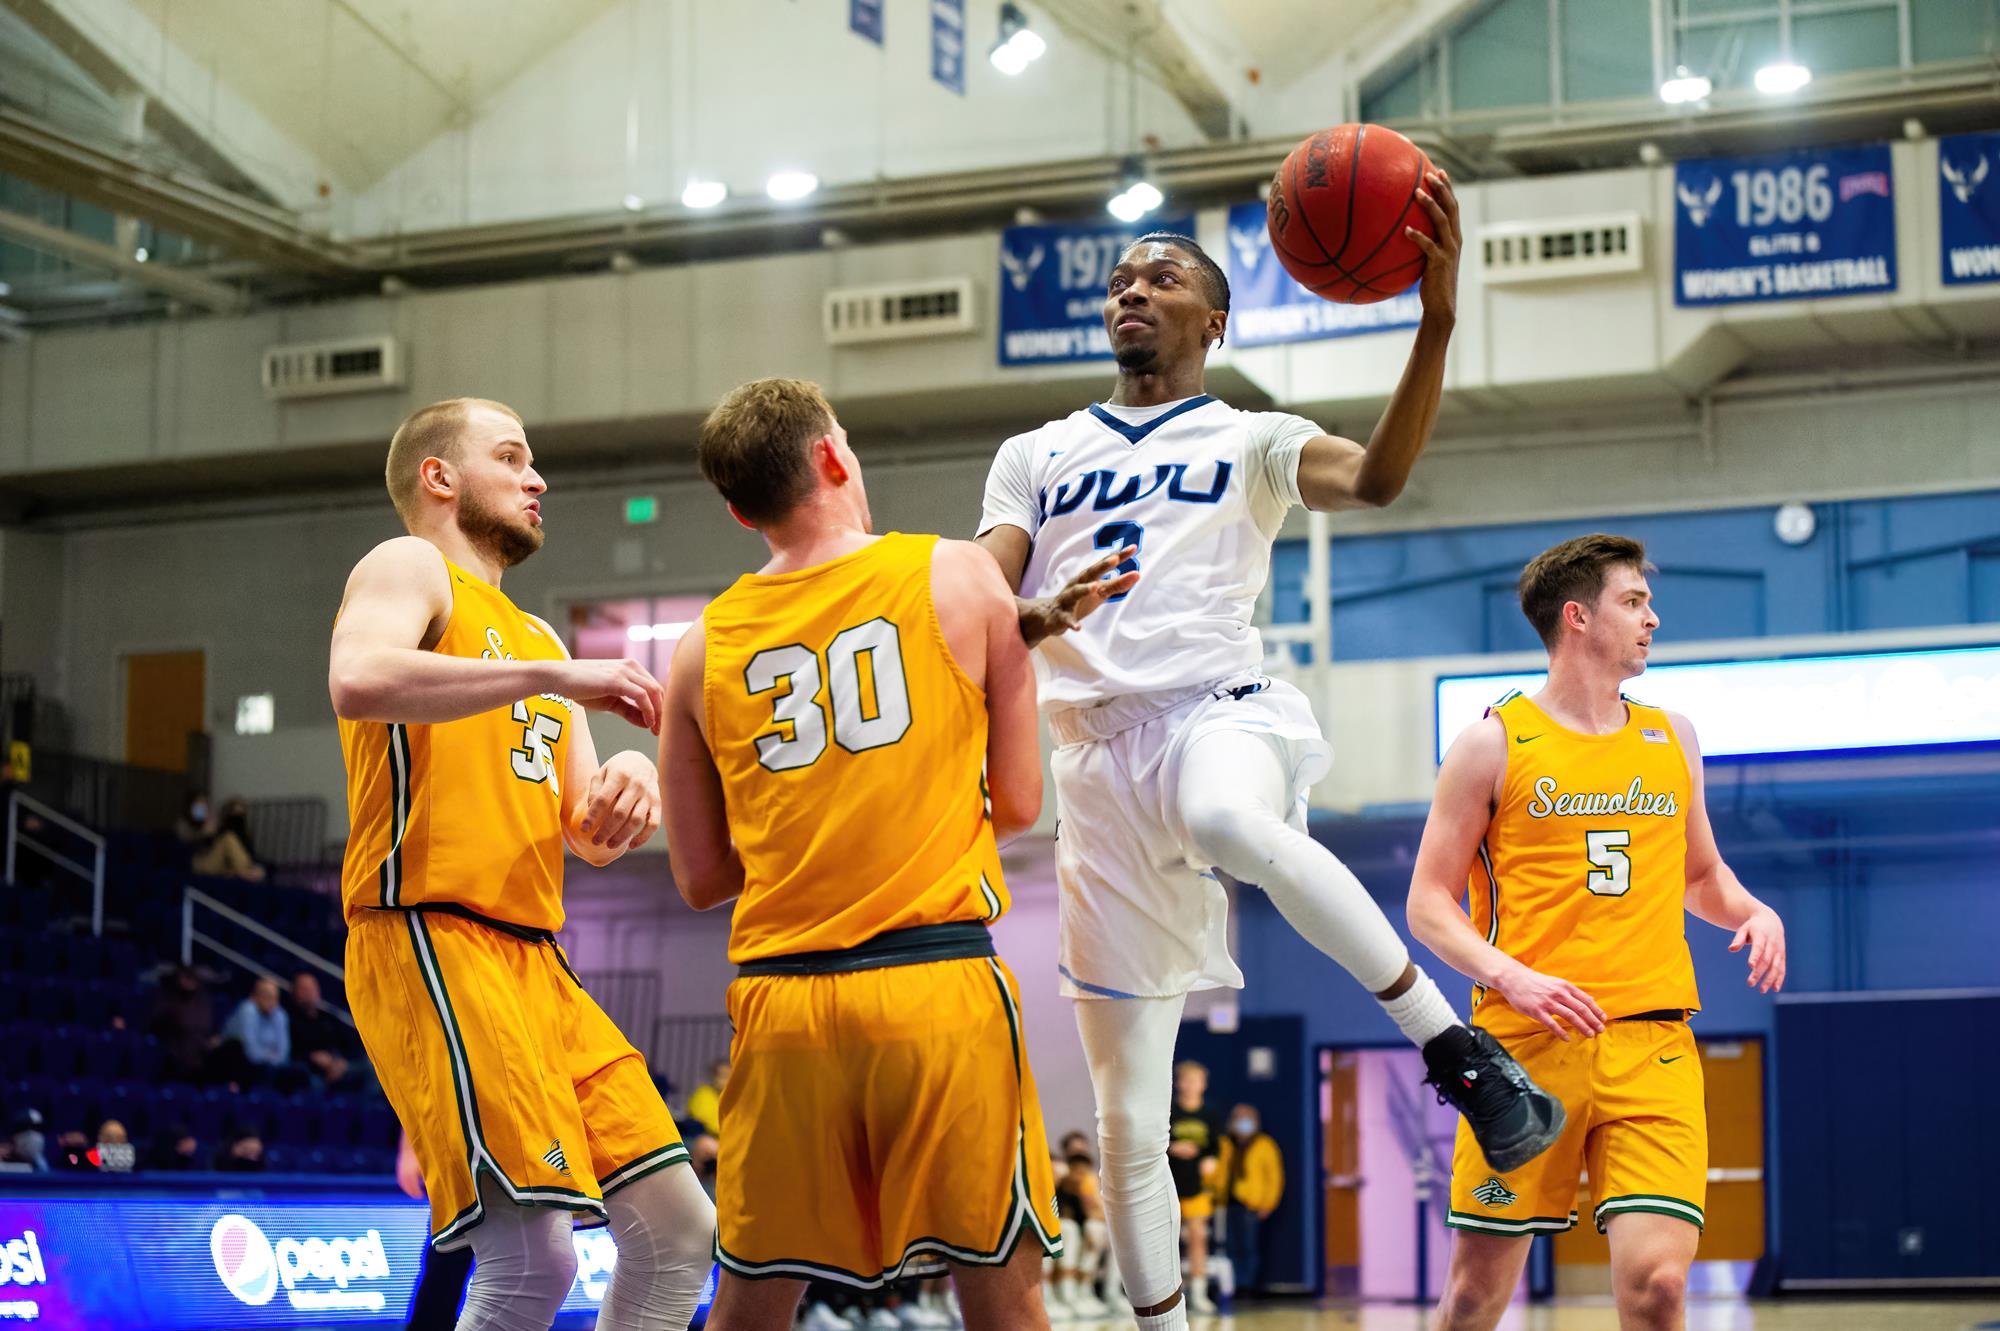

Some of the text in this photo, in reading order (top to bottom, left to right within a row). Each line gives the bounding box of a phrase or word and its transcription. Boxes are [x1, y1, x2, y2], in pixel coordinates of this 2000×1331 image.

[1732, 164, 1833, 227] 1986
[1056, 235, 1133, 290] 197
[1682, 255, 1890, 299] WOMEN'S BASKETBALL
[1038, 459, 1233, 528] WWU
[1092, 519, 1145, 604] 3
[742, 615, 913, 774] 30
[510, 700, 564, 798] 35
[1527, 775, 1679, 819] Seawolves
[1585, 829, 1631, 897] 5
[275, 1228, 391, 1290] pepsi
